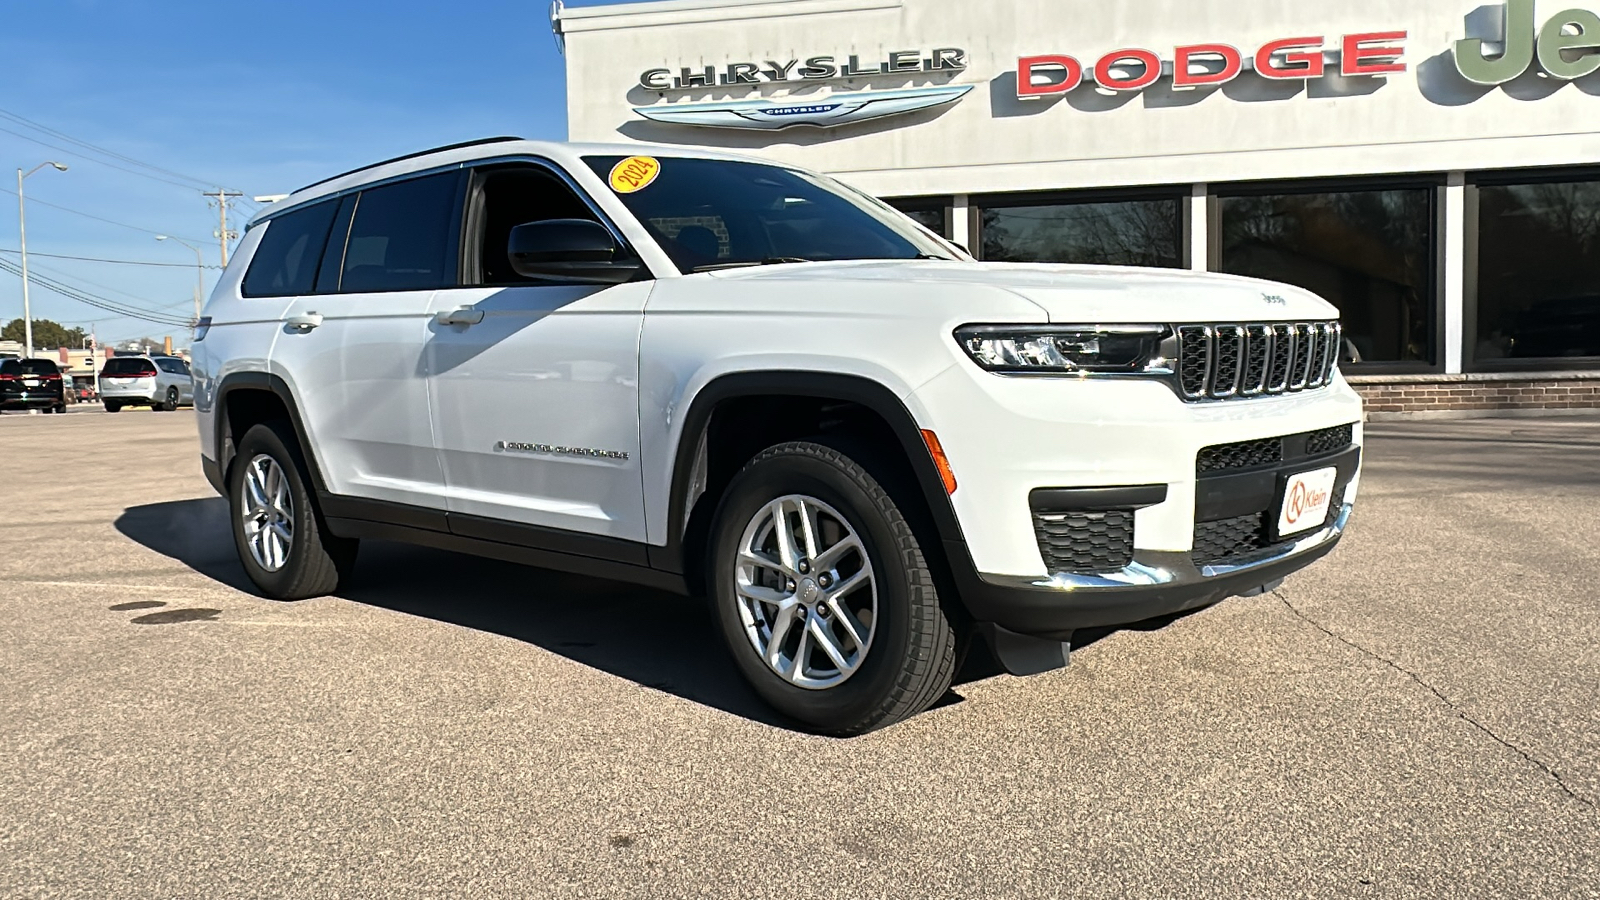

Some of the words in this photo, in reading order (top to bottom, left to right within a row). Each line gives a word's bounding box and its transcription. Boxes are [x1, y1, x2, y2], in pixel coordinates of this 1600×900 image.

[639, 47, 967, 90] CHRYSLER
[1016, 30, 1408, 97] DODGE
[766, 105, 832, 115] CHRYSLER
[618, 158, 654, 187] 2024
[1305, 488, 1327, 509] Klein
